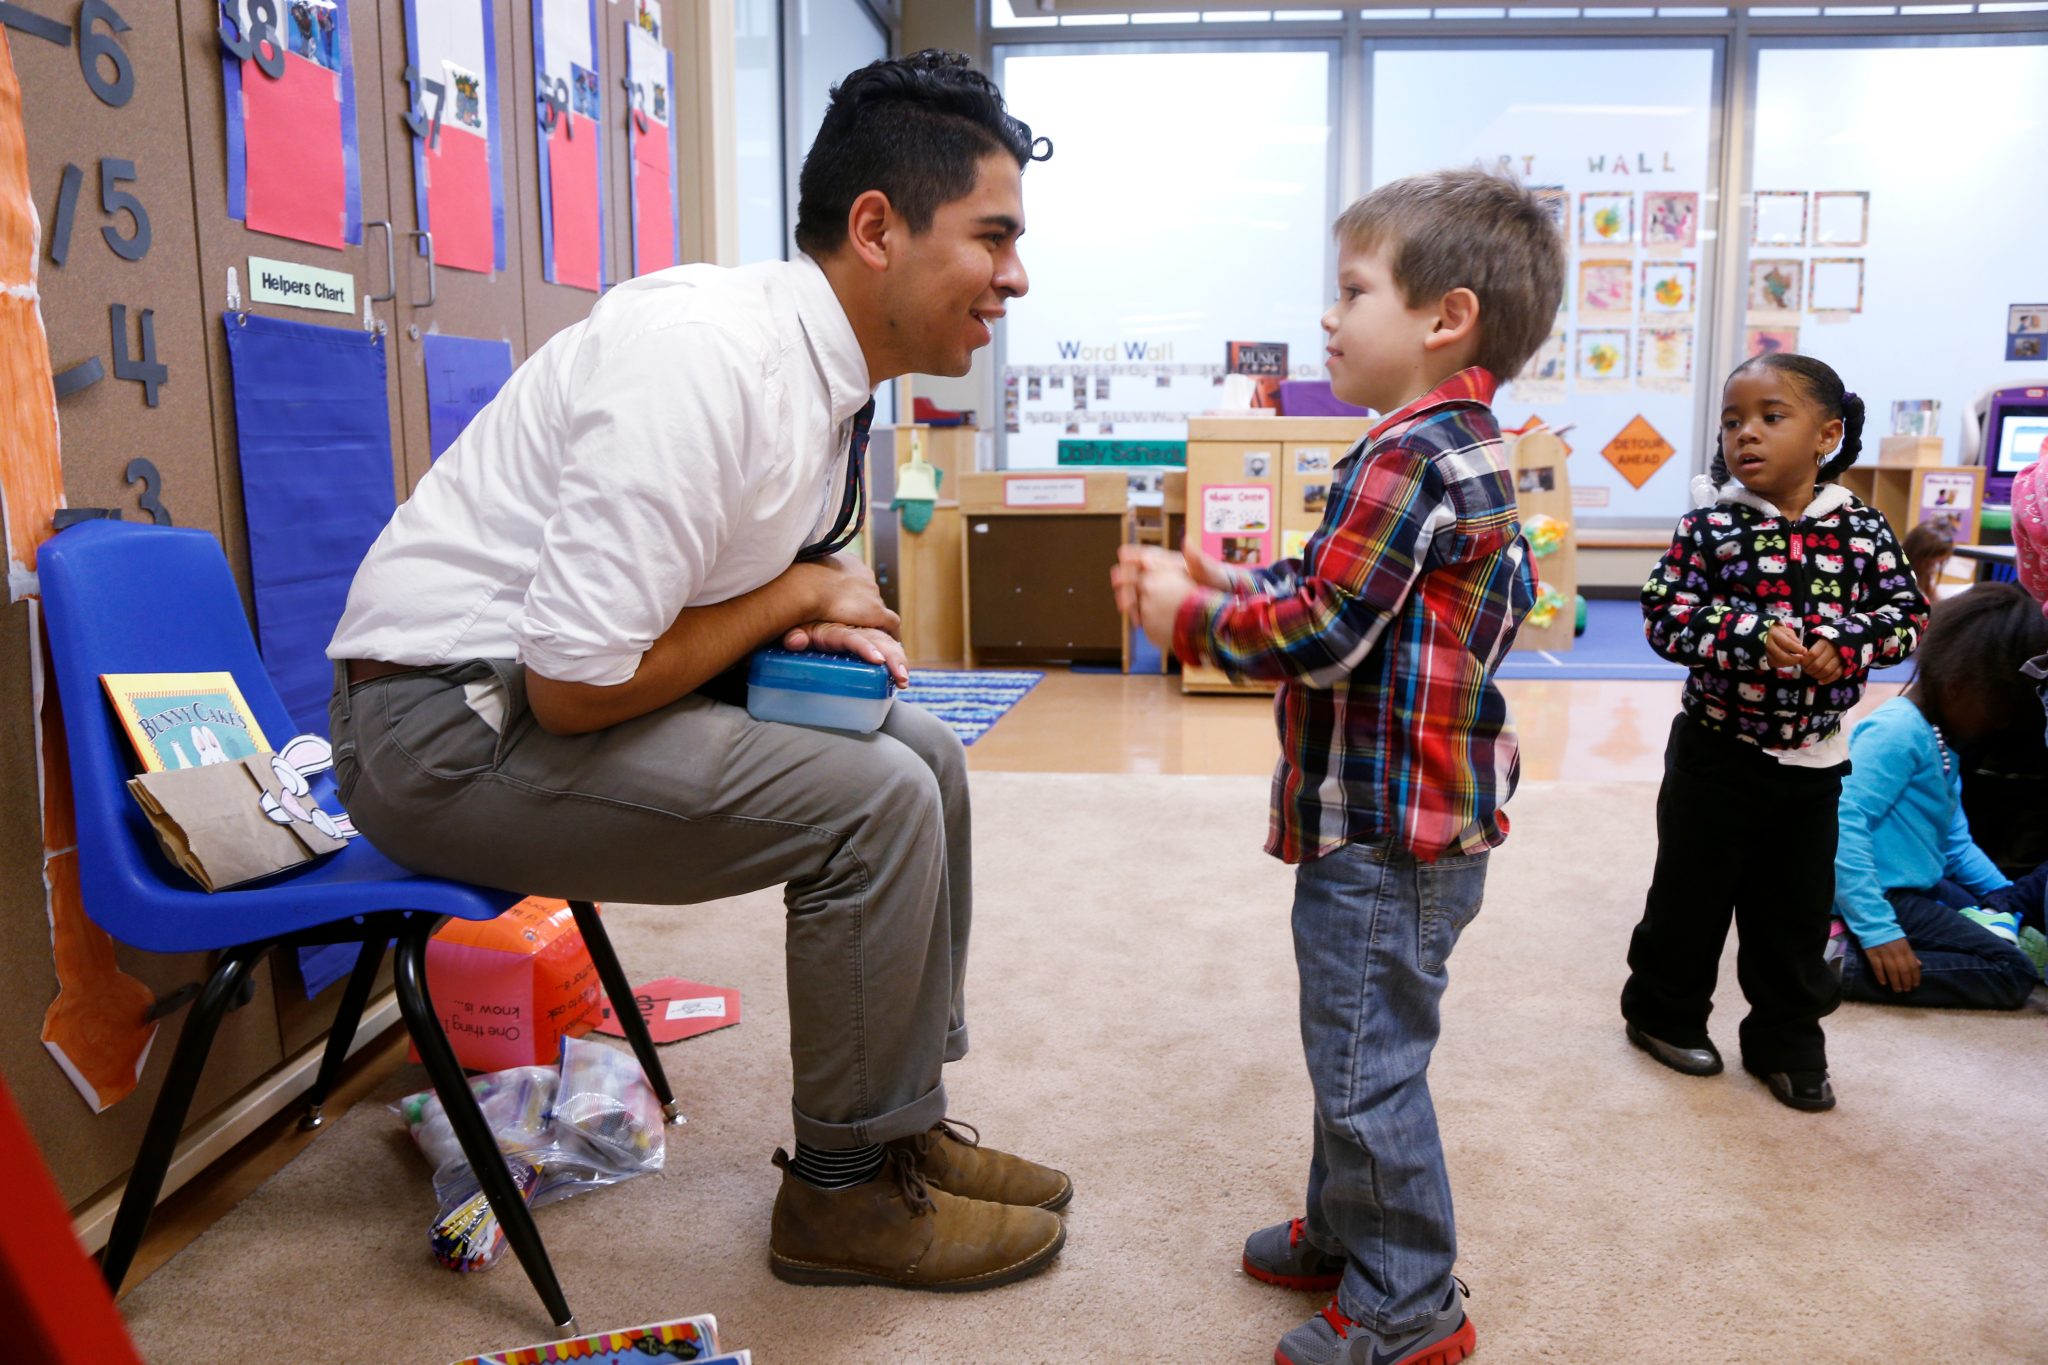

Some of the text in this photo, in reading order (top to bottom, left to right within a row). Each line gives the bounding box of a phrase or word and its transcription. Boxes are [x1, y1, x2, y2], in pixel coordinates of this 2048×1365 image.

[1587, 151, 1675, 176] WALL
[261, 271, 345, 303] Helpers Chart
[1057, 341, 1173, 362] Word Wall
[1239, 351, 1282, 365] MUSIC
[1058, 441, 1105, 465] Daily
[1613, 438, 1664, 450] DETOUR
[1617, 454, 1661, 465] AHEAD
[137, 706, 194, 742] BUNNY
[479, 1004, 520, 1020] know
[546, 1004, 567, 1023] ask
[452, 1013, 485, 1039] thing
[488, 1026, 520, 1041] One
